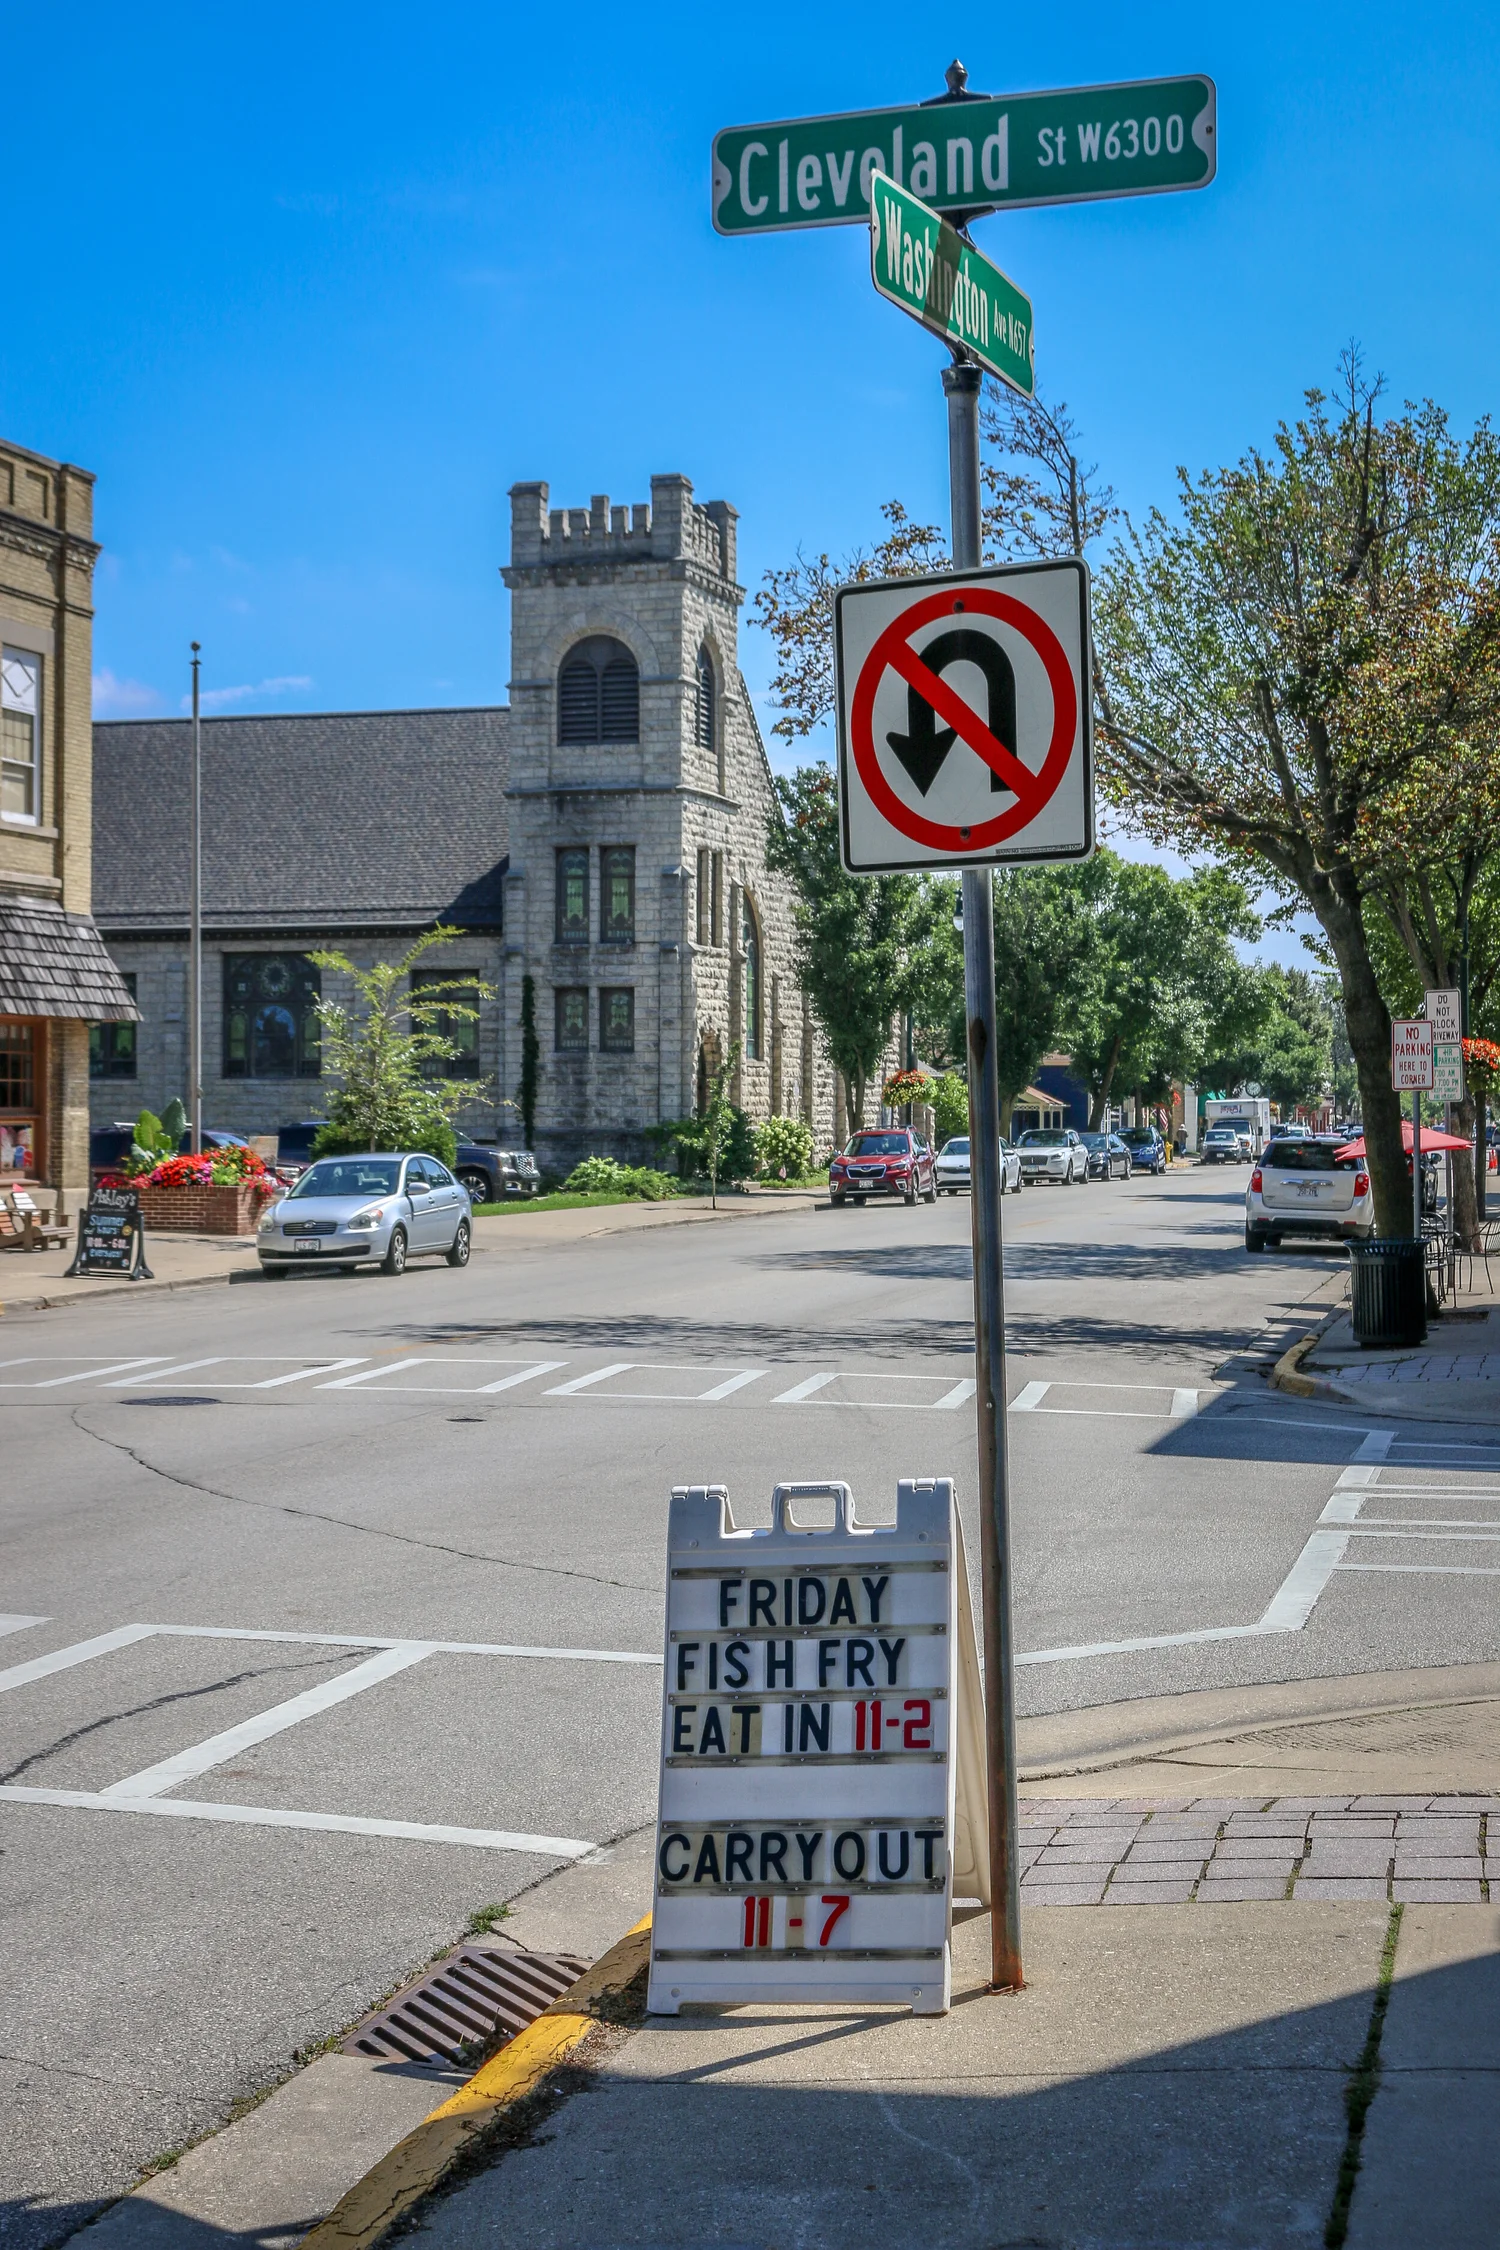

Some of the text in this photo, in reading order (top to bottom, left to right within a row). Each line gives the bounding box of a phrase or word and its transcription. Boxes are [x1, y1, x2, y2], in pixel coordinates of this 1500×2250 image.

[738, 113, 1184, 216] Cleveland St W6300
[884, 195, 1027, 361] Washington Ave N657
[1438, 994, 1448, 1004] DO
[1436, 1006, 1450, 1016] NOT
[1406, 1027, 1419, 1040] NO
[1433, 1031, 1458, 1041] RIVEWAY
[1395, 1043, 1431, 1056] PARKING
[1399, 1061, 1427, 1071] HERE TO
[1438, 1056, 1460, 1065] PARKING
[1401, 1074, 1426, 1085] CORNER
[89, 1188, 136, 1208] Ashley's
[718, 1575, 890, 1627] FRIDAY
[676, 1638, 906, 1690] FISH FRY
[673, 1699, 931, 1754] EAT IN 11-2
[659, 1830, 944, 1884] CARRYOUT
